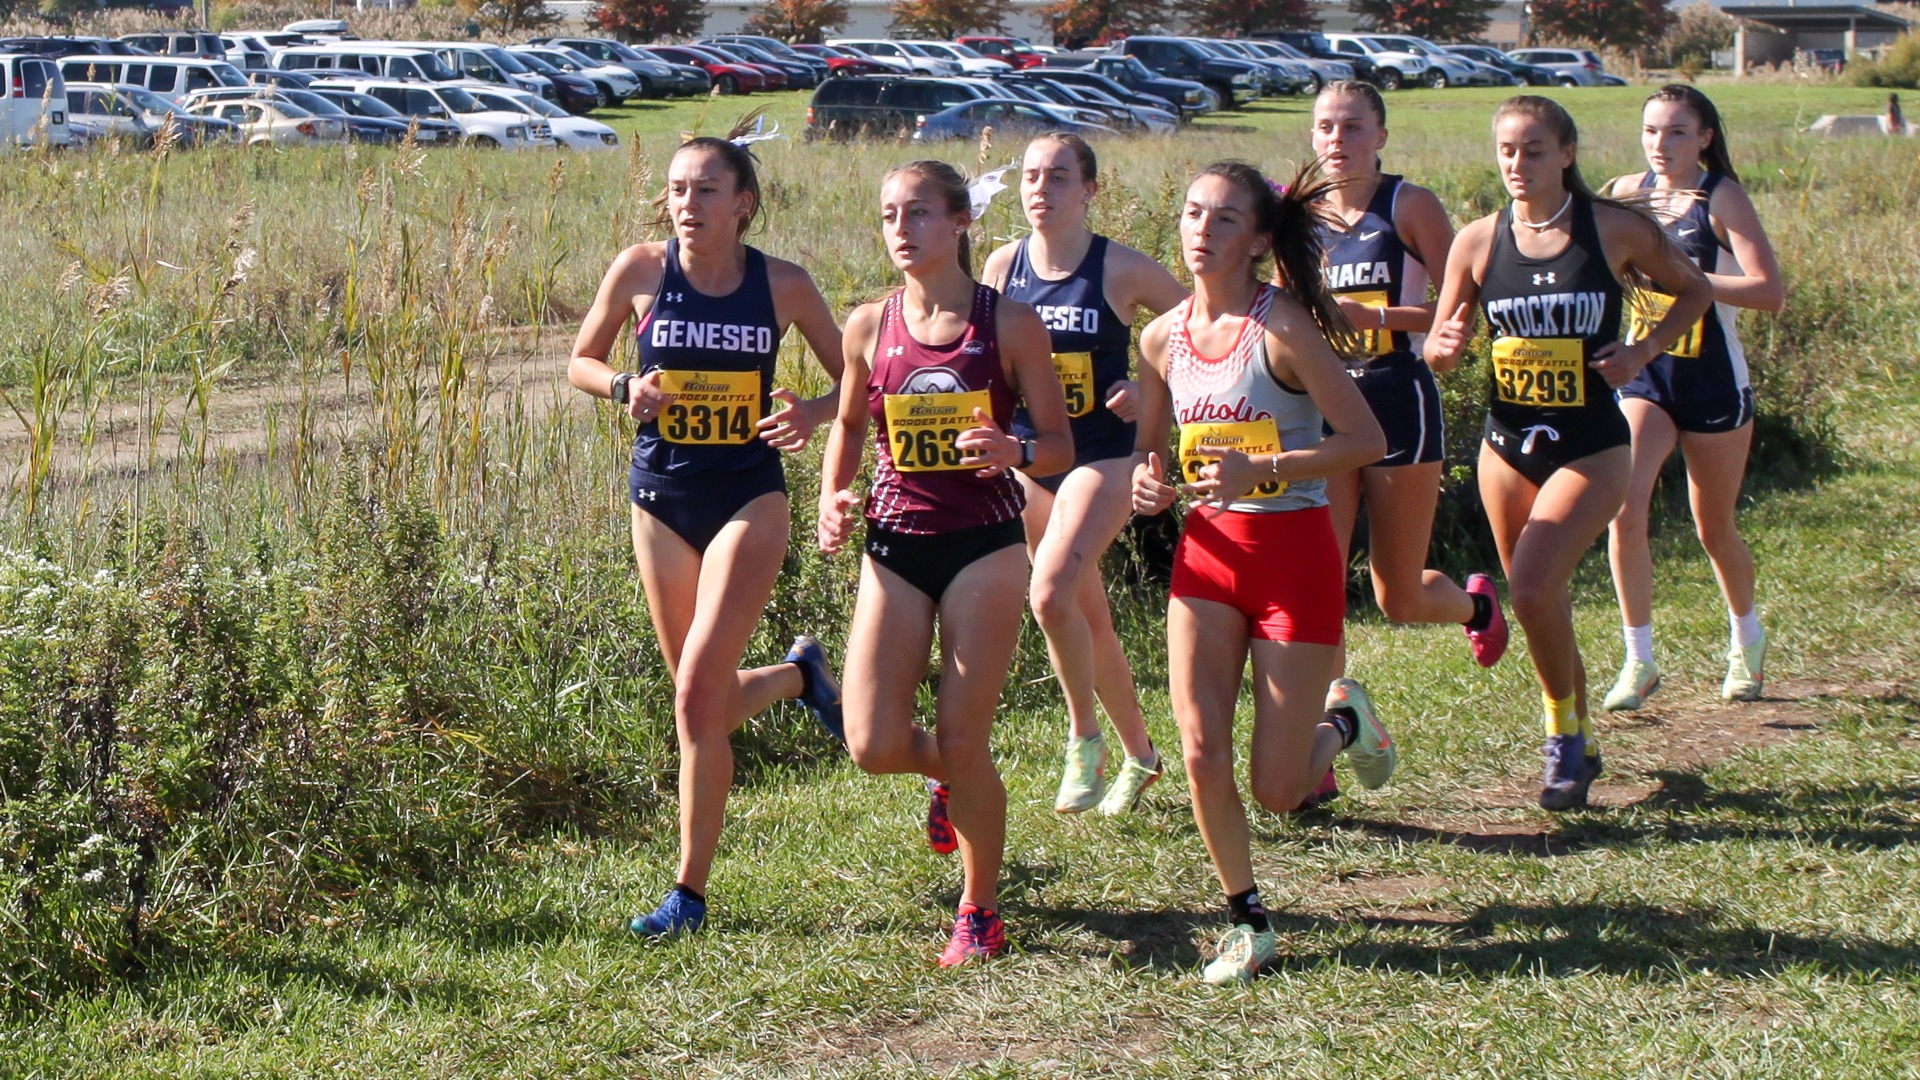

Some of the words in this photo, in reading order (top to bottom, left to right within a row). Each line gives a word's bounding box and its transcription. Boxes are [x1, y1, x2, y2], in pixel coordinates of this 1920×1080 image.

[1325, 261, 1391, 288] HACA
[1035, 305, 1099, 334] ESEO
[1487, 292, 1606, 337] STOCKTON
[651, 319, 772, 354] GENESEO
[1497, 358, 1535, 366] BORDER
[1537, 359, 1578, 367] BATTLE
[711, 393, 756, 402] BATTLE
[1500, 368, 1577, 403] 3293
[667, 404, 751, 441] 3314
[892, 418, 937, 426] BORDER
[939, 416, 979, 425] BATTL
[895, 427, 987, 467] 263
